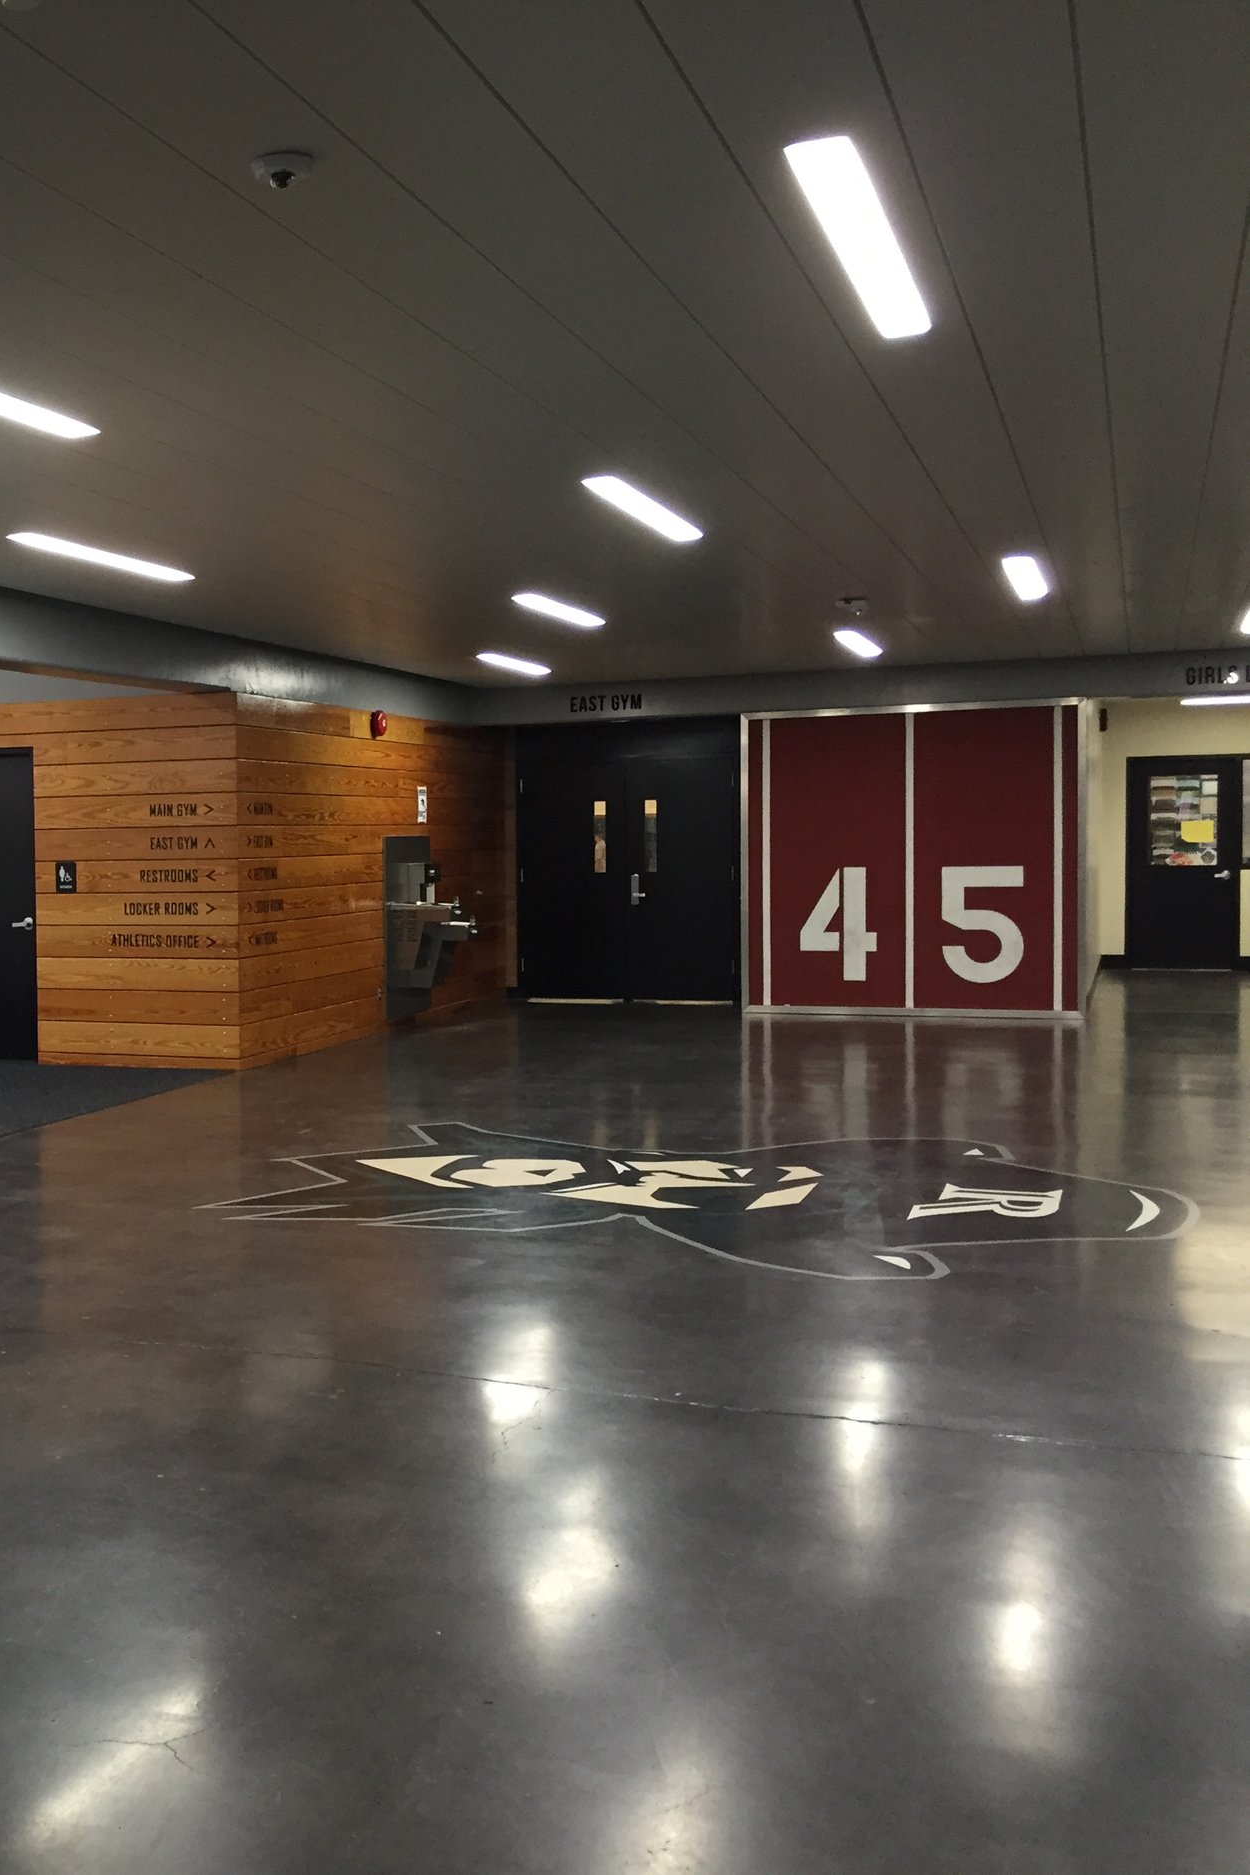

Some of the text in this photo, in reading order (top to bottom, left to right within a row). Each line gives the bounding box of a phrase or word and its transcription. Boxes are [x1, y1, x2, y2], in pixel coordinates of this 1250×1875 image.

[570, 693, 642, 712] EAST GYM
[150, 803, 197, 817] MAIN GYM
[150, 837, 198, 850] EAST GYM
[139, 869, 198, 883] RESTROOMS
[124, 902, 198, 915] LOCKER ROOMS
[111, 933, 199, 948] ATHLETICS OFFICE
